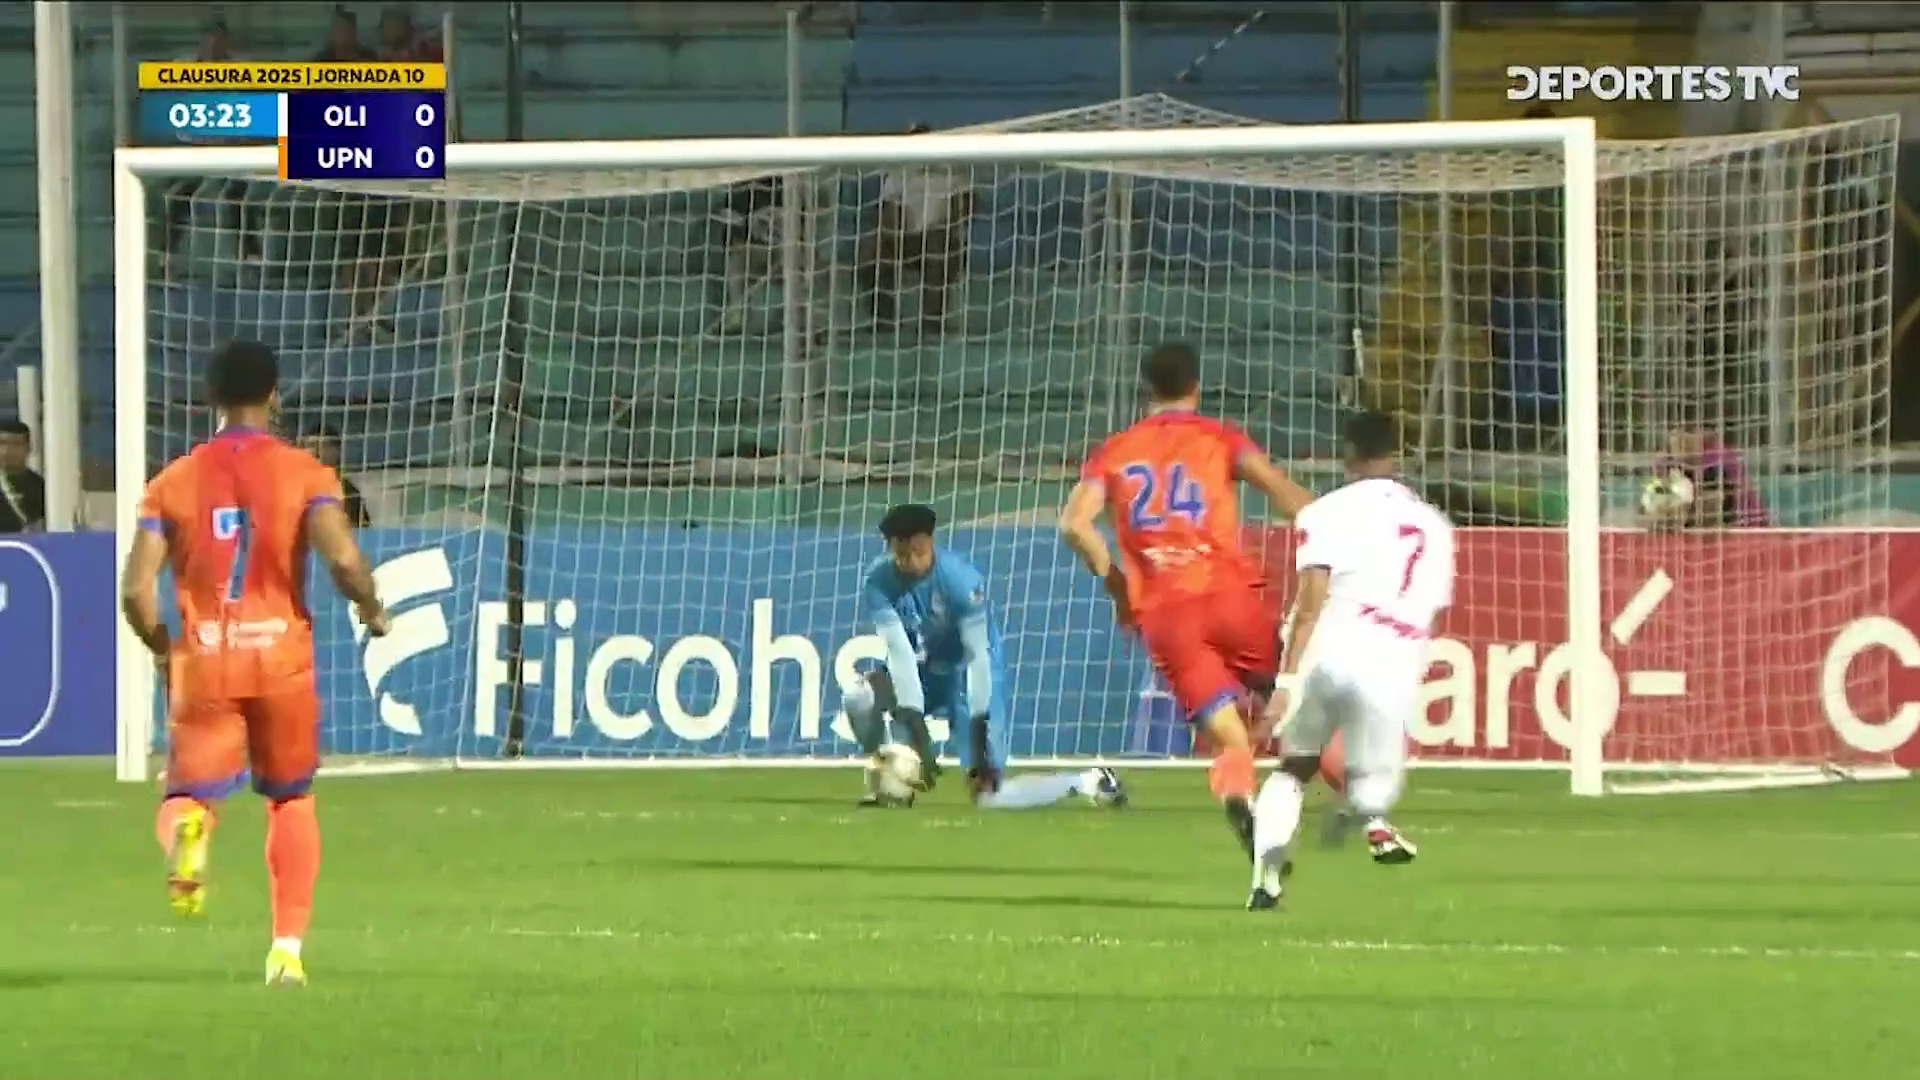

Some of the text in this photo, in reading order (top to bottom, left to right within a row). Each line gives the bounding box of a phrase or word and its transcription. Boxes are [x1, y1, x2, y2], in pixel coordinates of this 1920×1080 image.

[1122, 462, 1205, 531] 24
[1397, 523, 1426, 598] 7
[474, 597, 949, 742] Ficohs
[1404, 636, 1620, 752] aro
